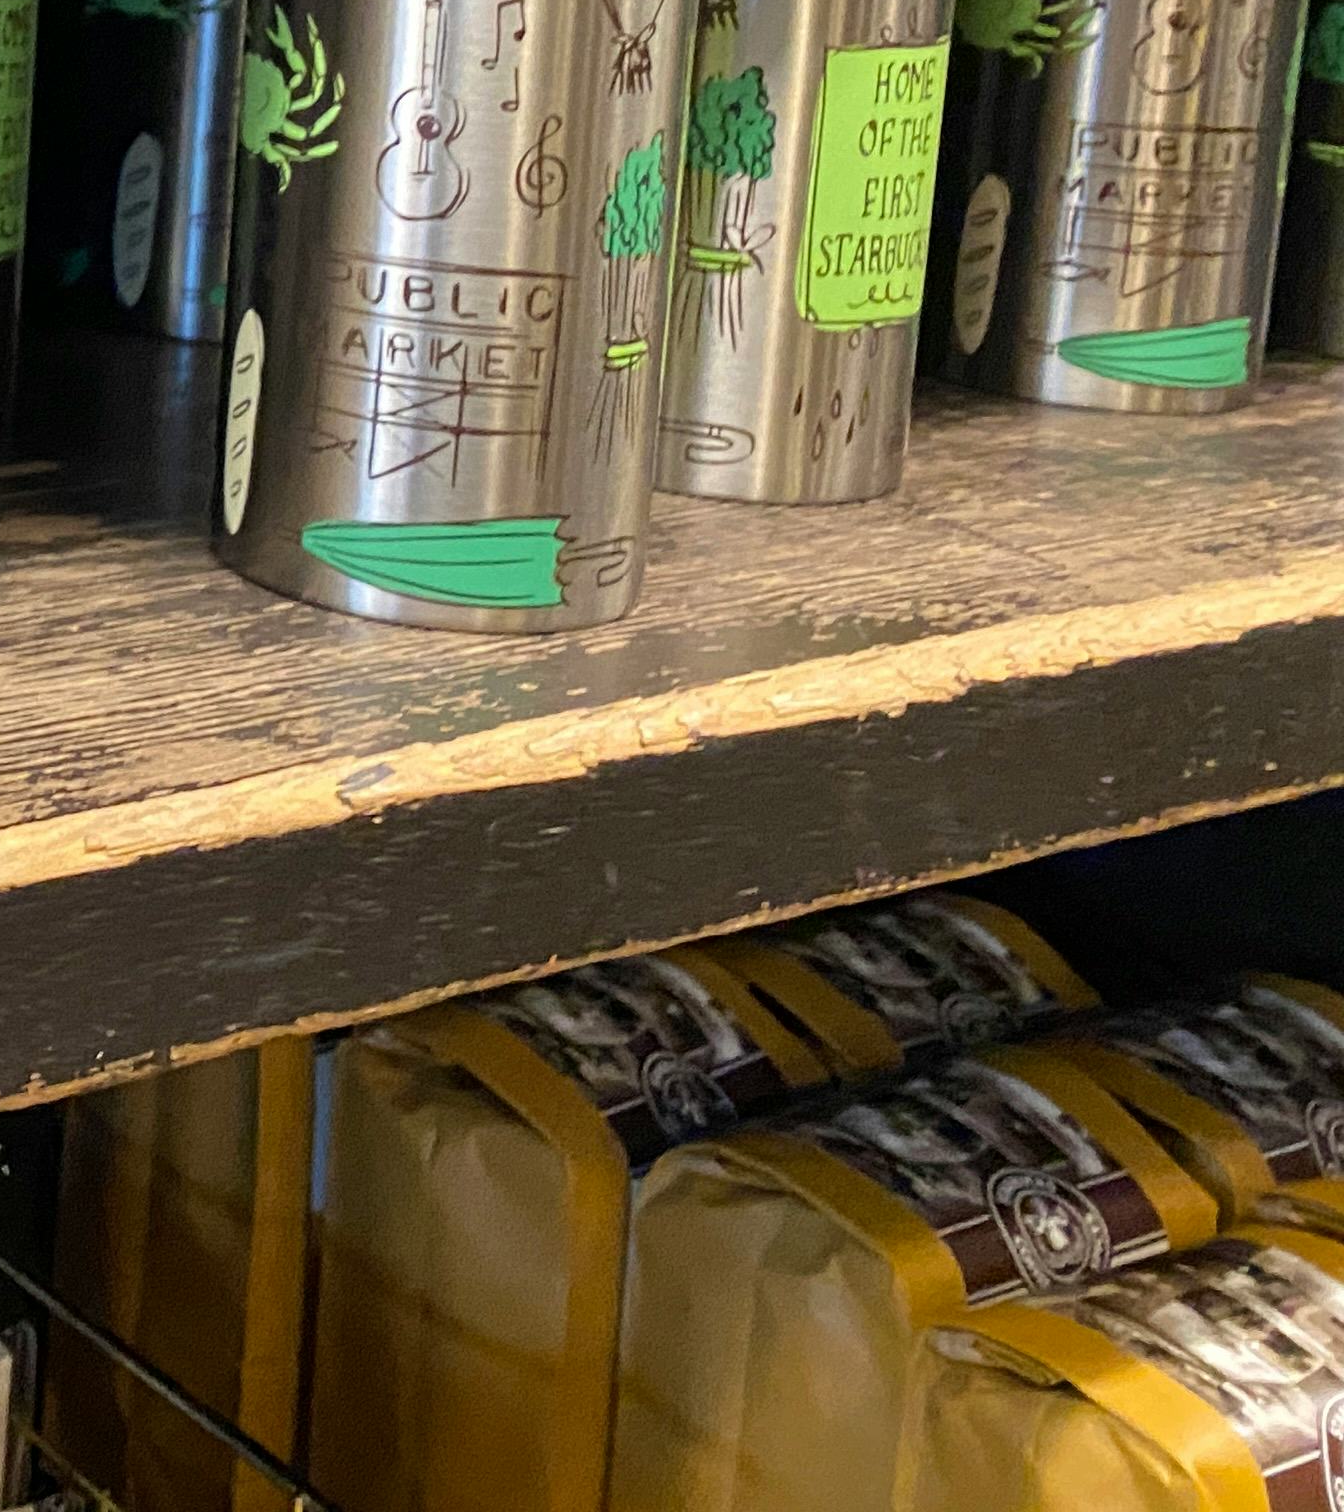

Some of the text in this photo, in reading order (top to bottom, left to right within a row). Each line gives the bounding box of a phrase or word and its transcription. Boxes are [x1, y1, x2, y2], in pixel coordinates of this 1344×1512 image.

[874, 56, 938, 105] HOME
[858, 112, 934, 158] OF THE
[861, 171, 926, 220] FIRST
[324, 325, 548, 381] ARKET
